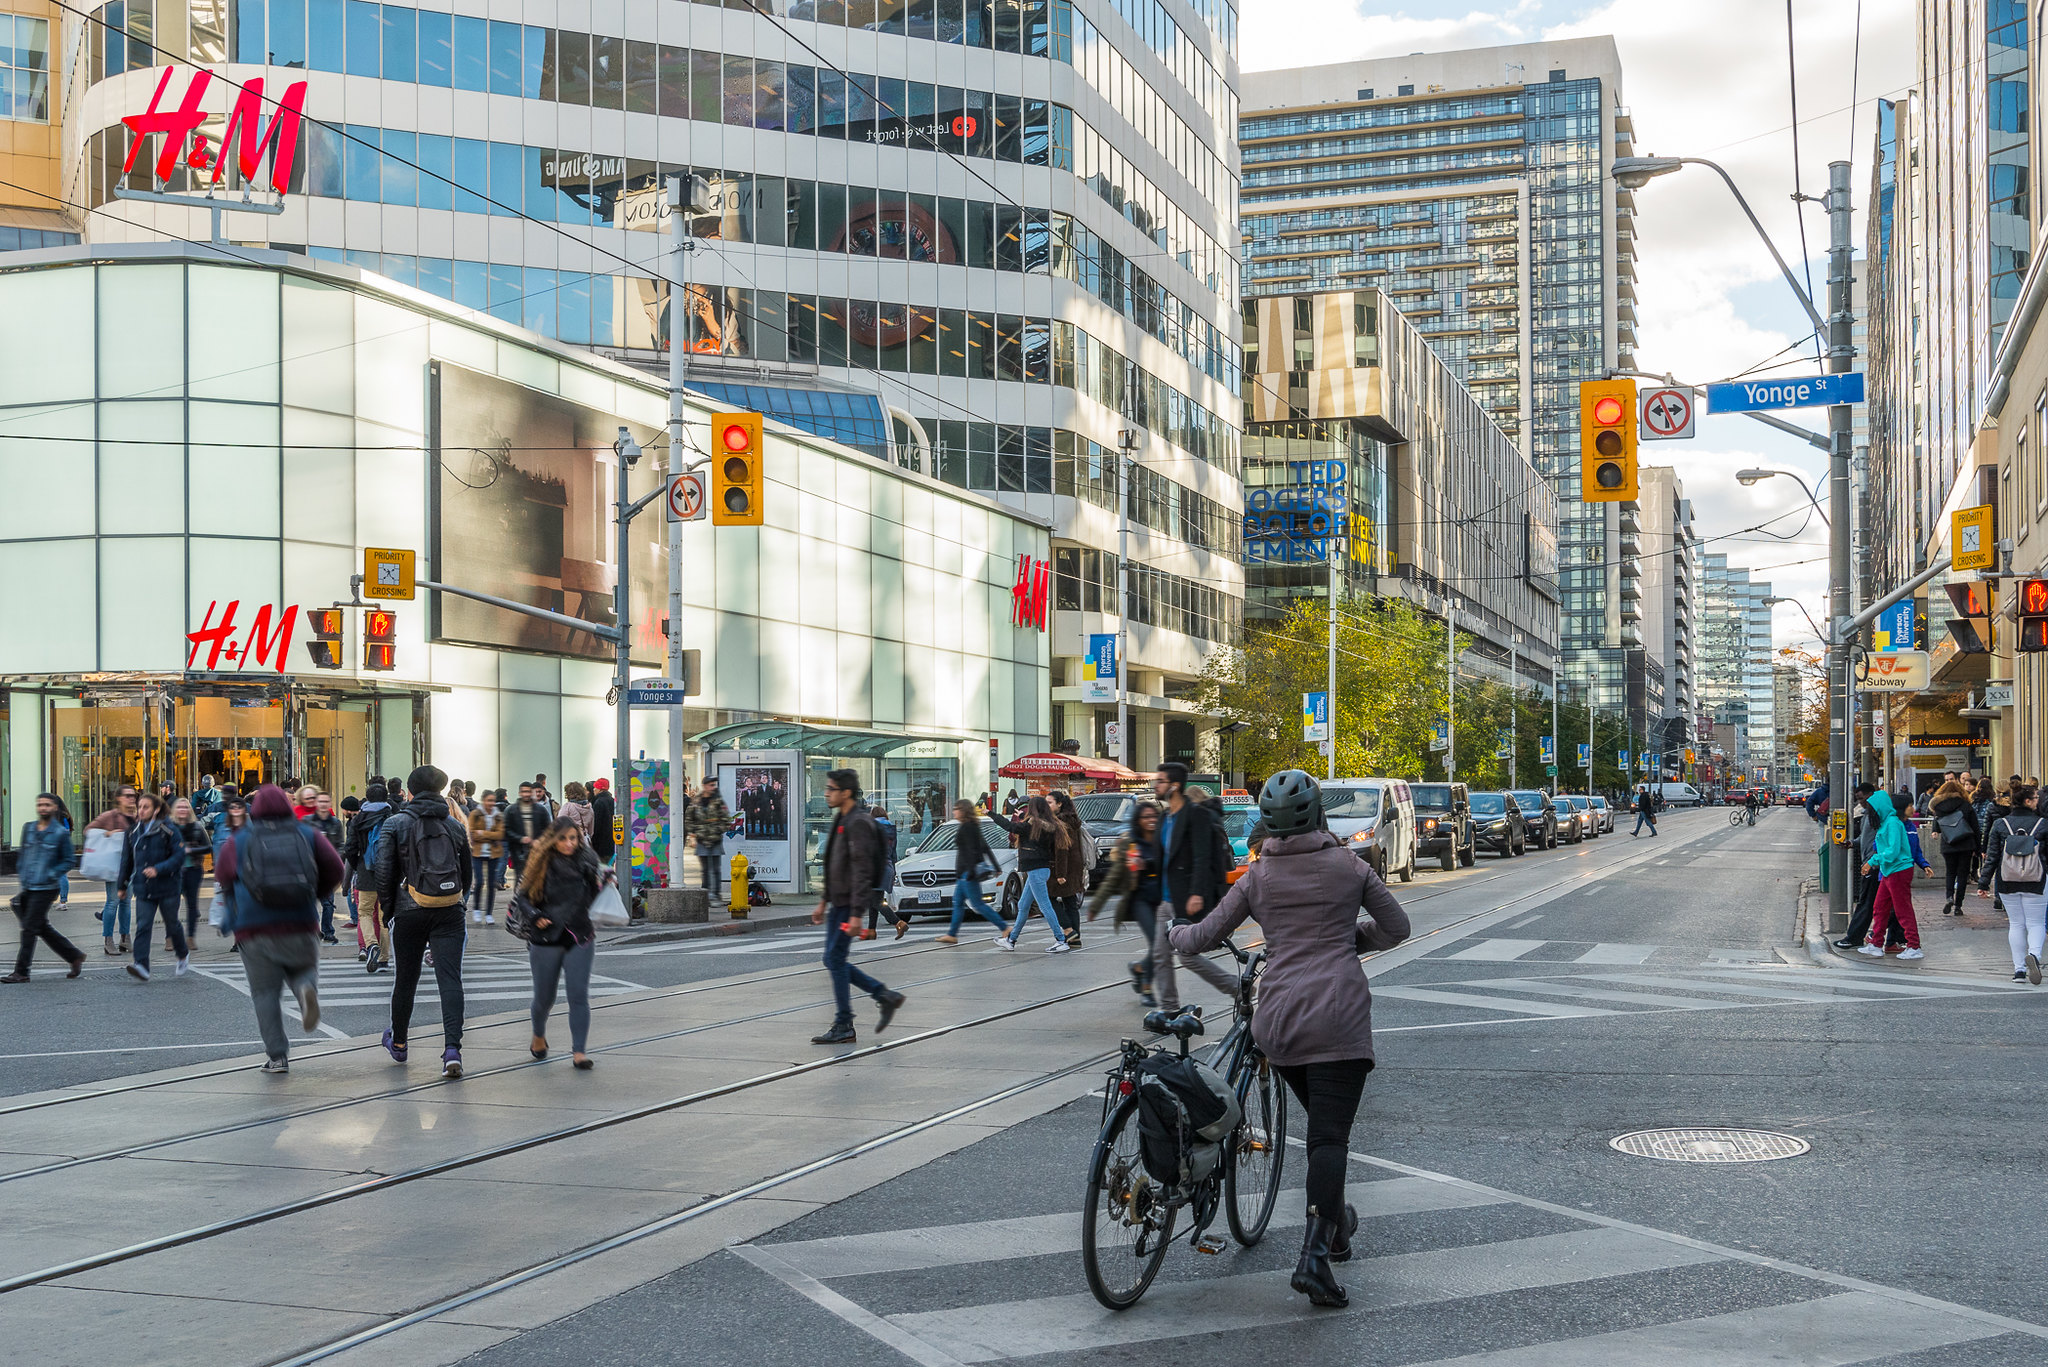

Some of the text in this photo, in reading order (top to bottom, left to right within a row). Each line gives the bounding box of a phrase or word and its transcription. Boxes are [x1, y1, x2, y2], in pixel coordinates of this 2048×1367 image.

[121, 65, 308, 195] H&M
[1744, 379, 1827, 407] Yonge St
[1290, 460, 1346, 484] TED
[1243, 512, 1346, 537] OOL OF
[1958, 511, 1983, 523] PRIORITY
[374, 551, 405, 560] PRIORITY
[1957, 553, 1986, 566] CROSSING
[371, 586, 407, 596] CROSSING
[1012, 553, 1049, 632] H&M
[1902, 606, 1911, 644] University
[186, 600, 299, 674] H&M
[1105, 639, 1113, 674] University
[1866, 678, 1906, 688] Subway
[639, 691, 673, 703] Yonge St
[1989, 691, 2010, 700] XXI
[747, 737, 780, 746] Yonge St
